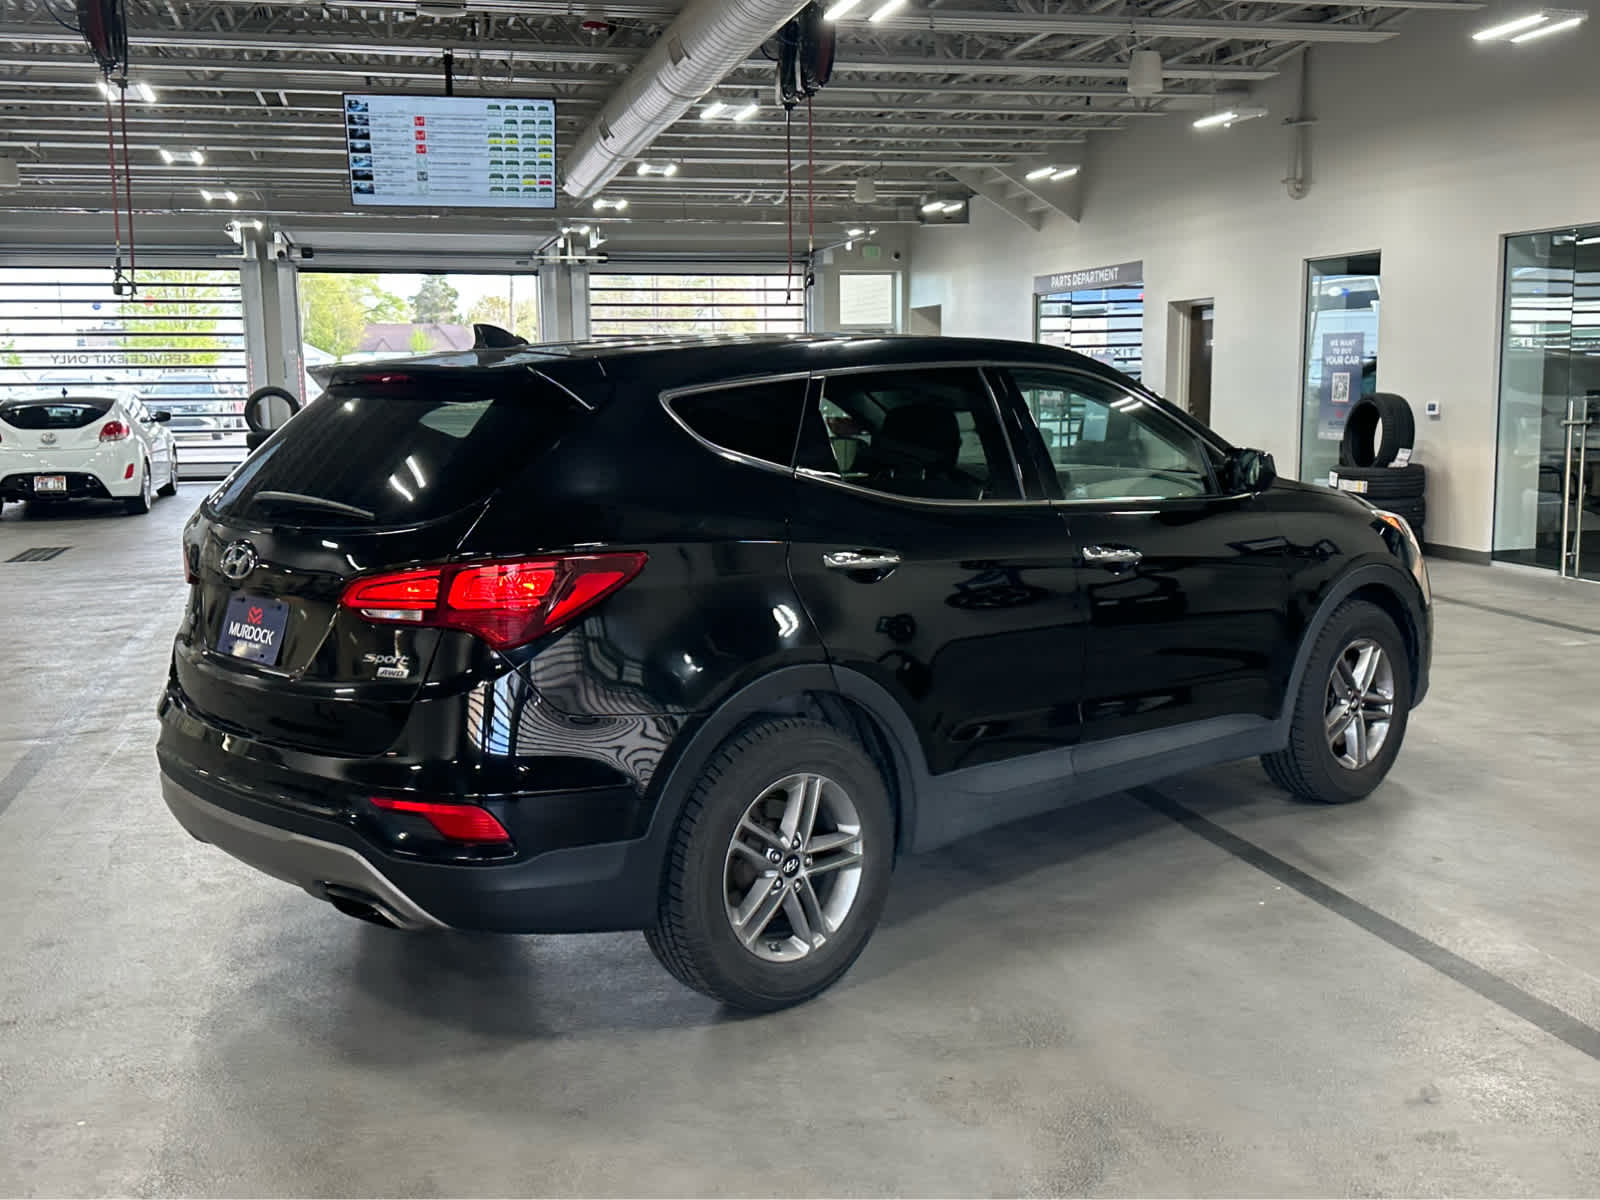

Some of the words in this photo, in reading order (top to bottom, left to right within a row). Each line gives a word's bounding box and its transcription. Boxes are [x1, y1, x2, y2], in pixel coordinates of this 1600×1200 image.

[1051, 273, 1071, 288] PARTS
[1072, 267, 1119, 287] DEPARTMENT
[1325, 356, 1344, 365] YOUR
[1344, 355, 1360, 365] CAR
[228, 621, 275, 645] MURDOCK
[362, 653, 409, 664] Sport
[379, 669, 405, 678] AWD
